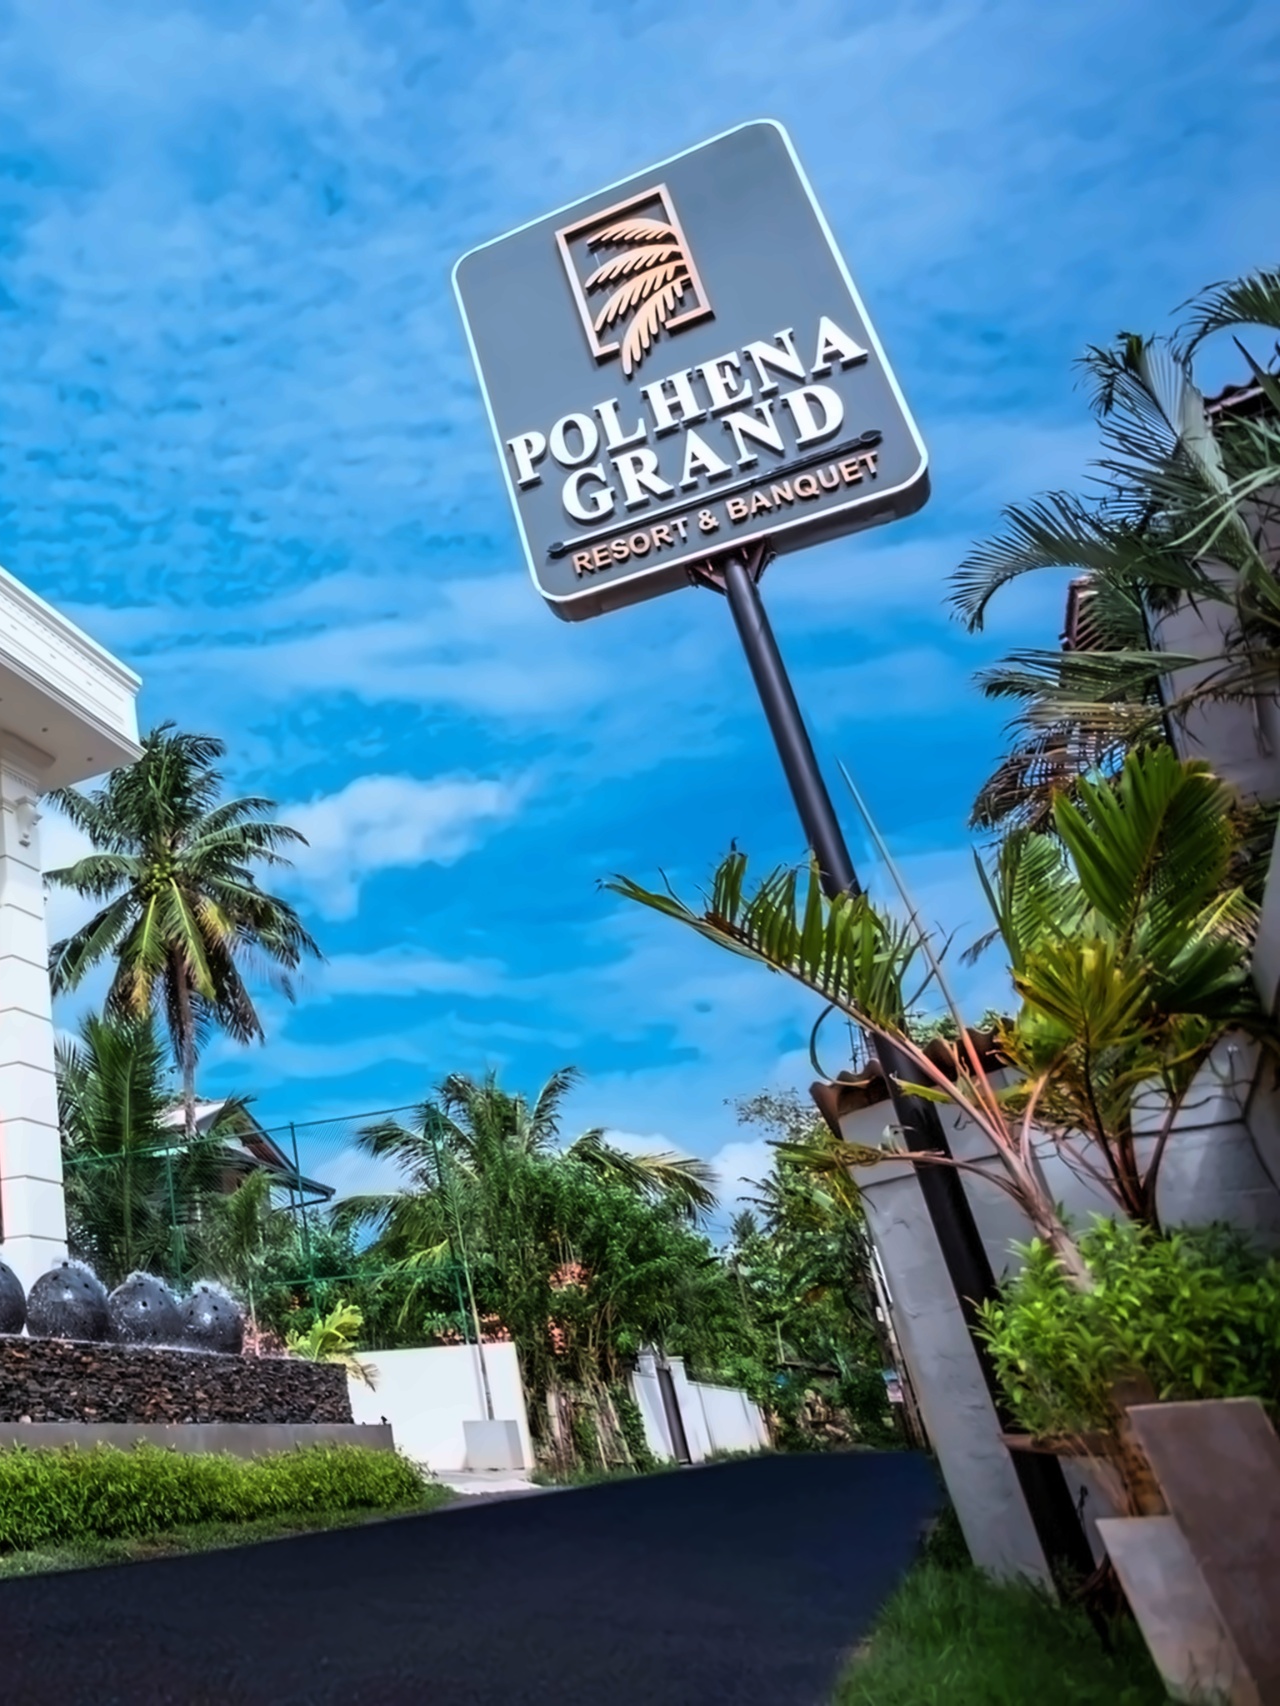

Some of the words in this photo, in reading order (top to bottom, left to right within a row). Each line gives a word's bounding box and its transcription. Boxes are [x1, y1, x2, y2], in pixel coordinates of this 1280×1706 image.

[506, 316, 868, 484] POLHENA
[562, 385, 845, 521] GRAND
[572, 517, 688, 574] RESORT
[698, 509, 719, 531] &
[726, 452, 879, 520] BANQUET
